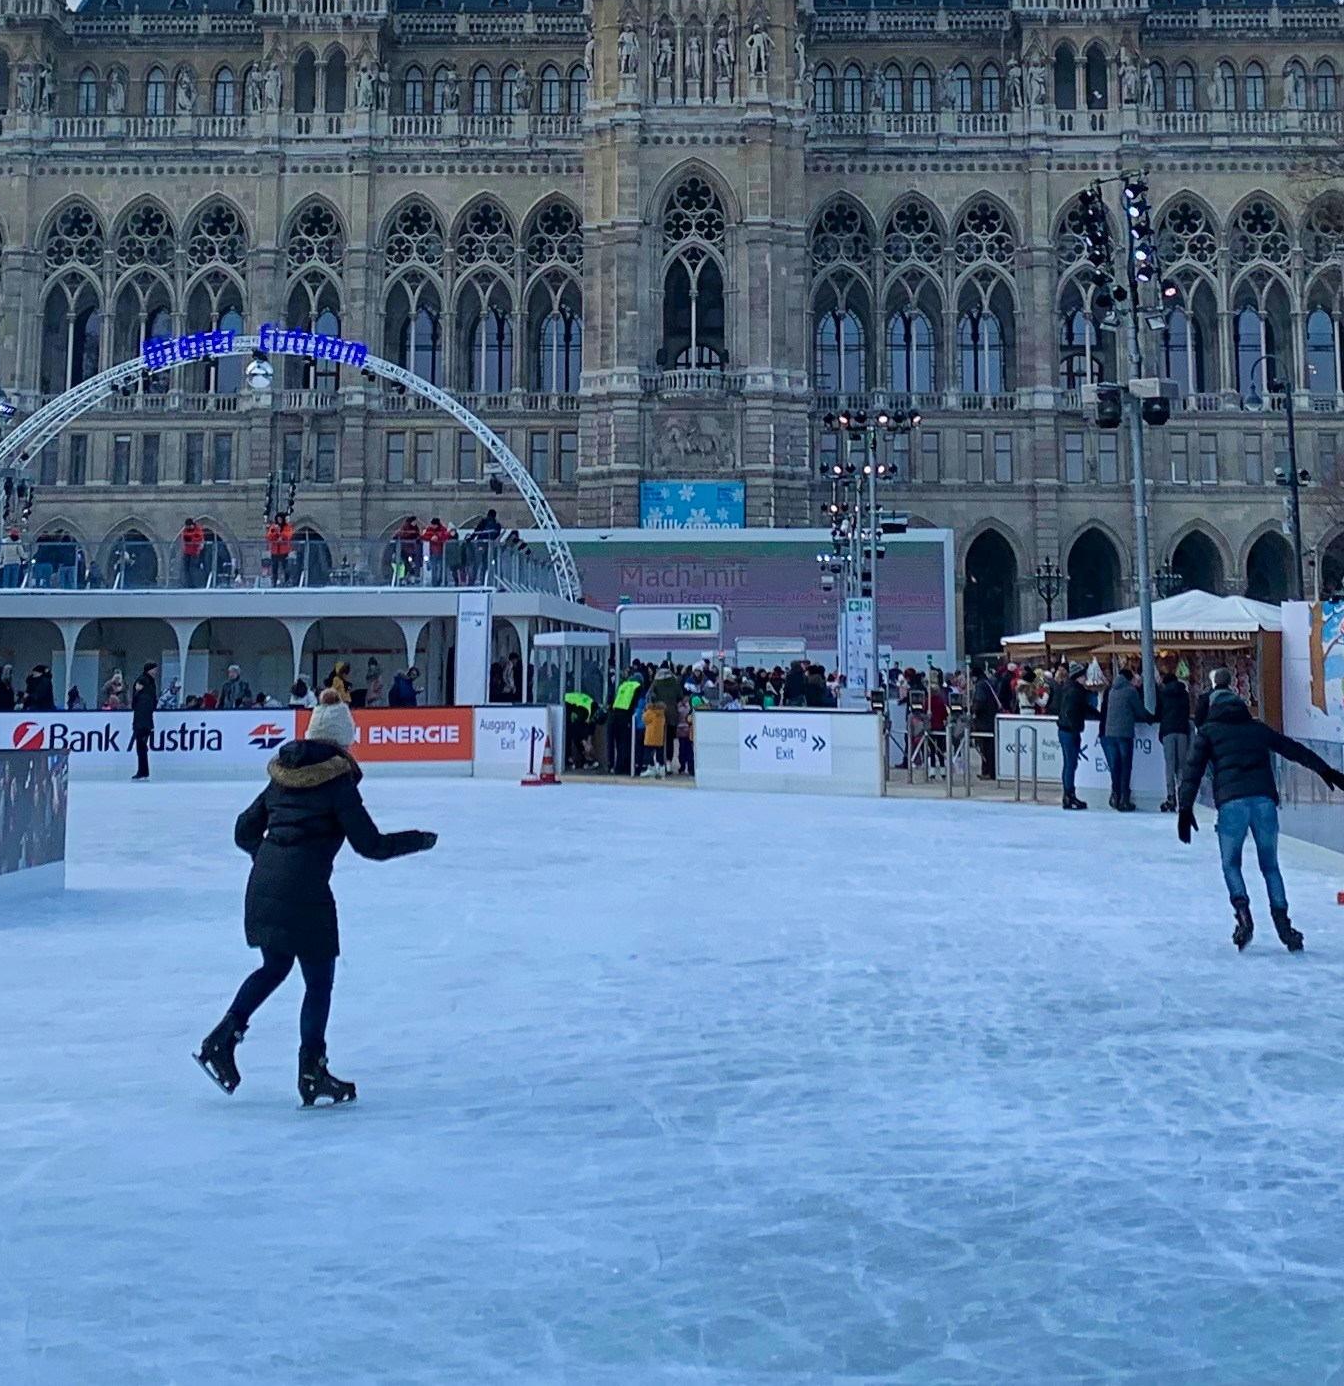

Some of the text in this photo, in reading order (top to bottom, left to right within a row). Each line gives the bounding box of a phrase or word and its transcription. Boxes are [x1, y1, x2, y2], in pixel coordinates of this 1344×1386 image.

[703, 563, 747, 588] mit
[479, 718, 516, 733] Ausgang
[761, 724, 807, 743] Ausgang
[49, 722, 120, 752] Bank
[368, 725, 460, 745] ENERGIE
[500, 738, 516, 750] Exit
[775, 746, 794, 760] Exit
[1095, 758, 1111, 773] Ex
